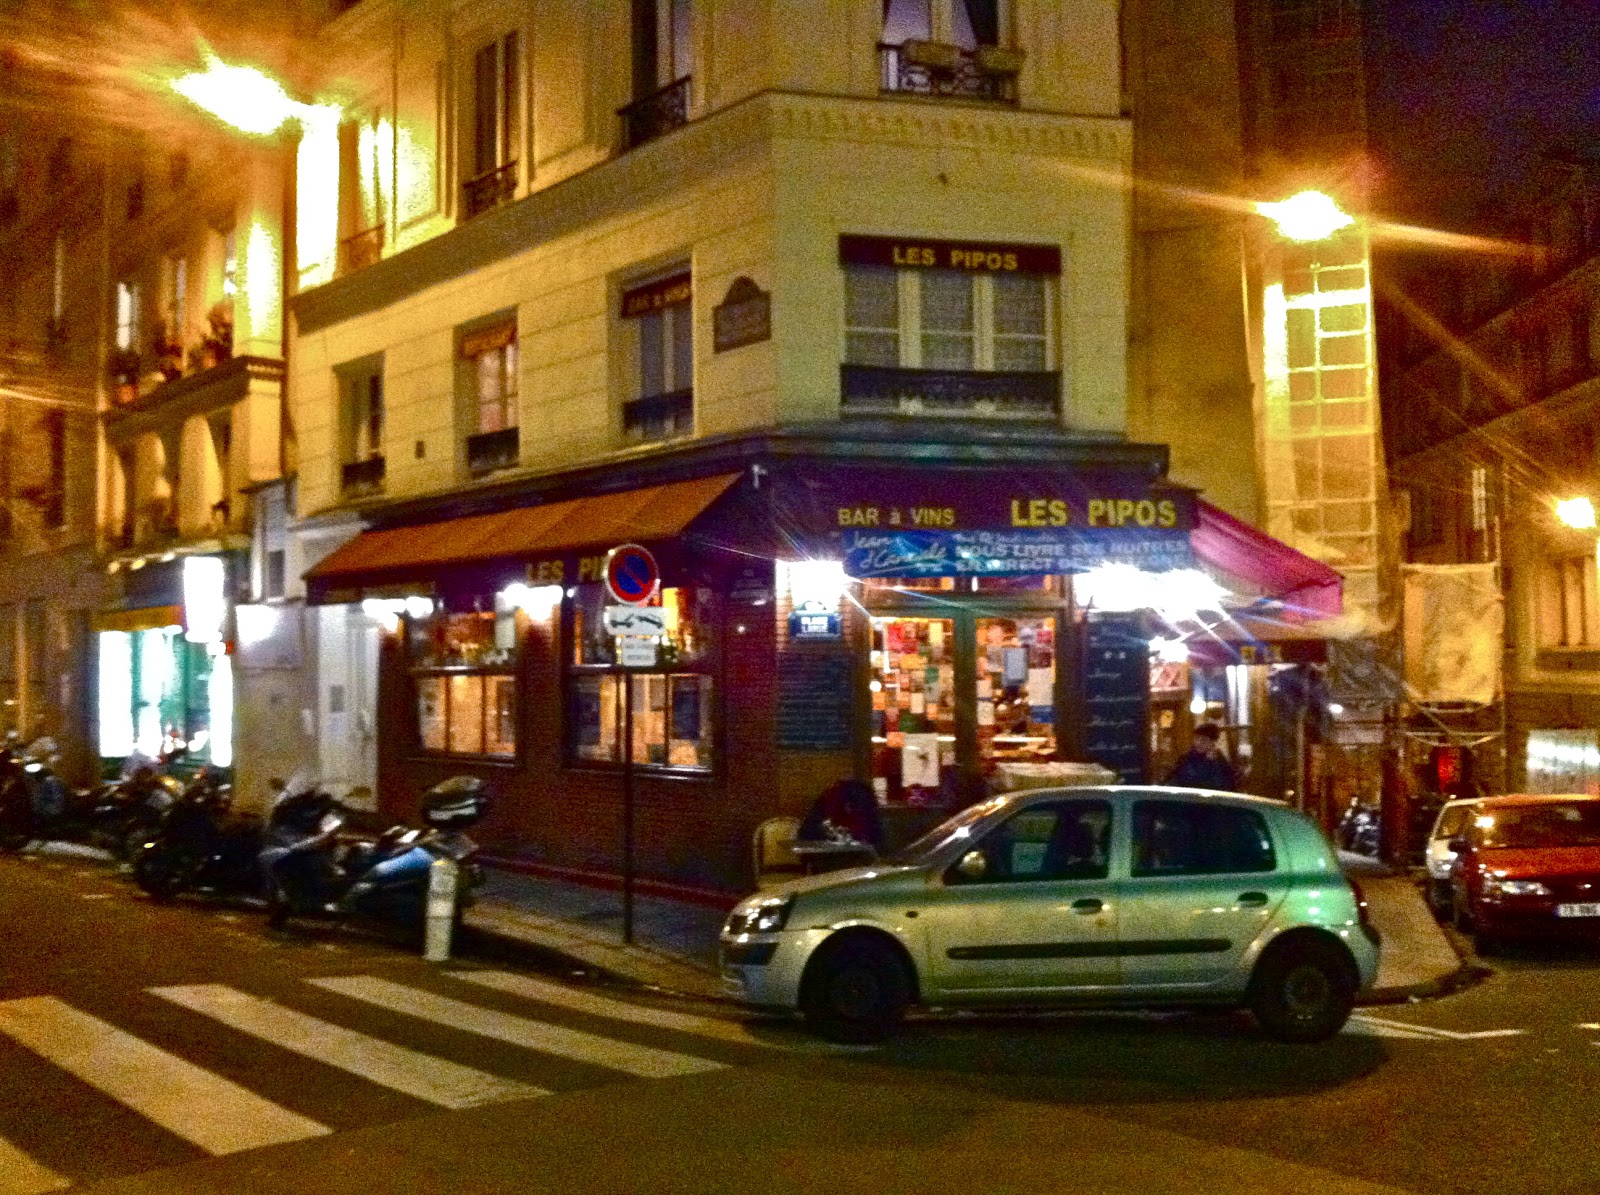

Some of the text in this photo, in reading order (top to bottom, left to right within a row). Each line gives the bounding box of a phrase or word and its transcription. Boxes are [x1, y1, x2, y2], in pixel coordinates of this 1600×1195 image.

[893, 246, 1018, 271] LES PIPOS
[838, 508, 879, 526] BAR
[909, 508, 955, 525] VINS
[1011, 499, 1177, 528] LES PIPOS
